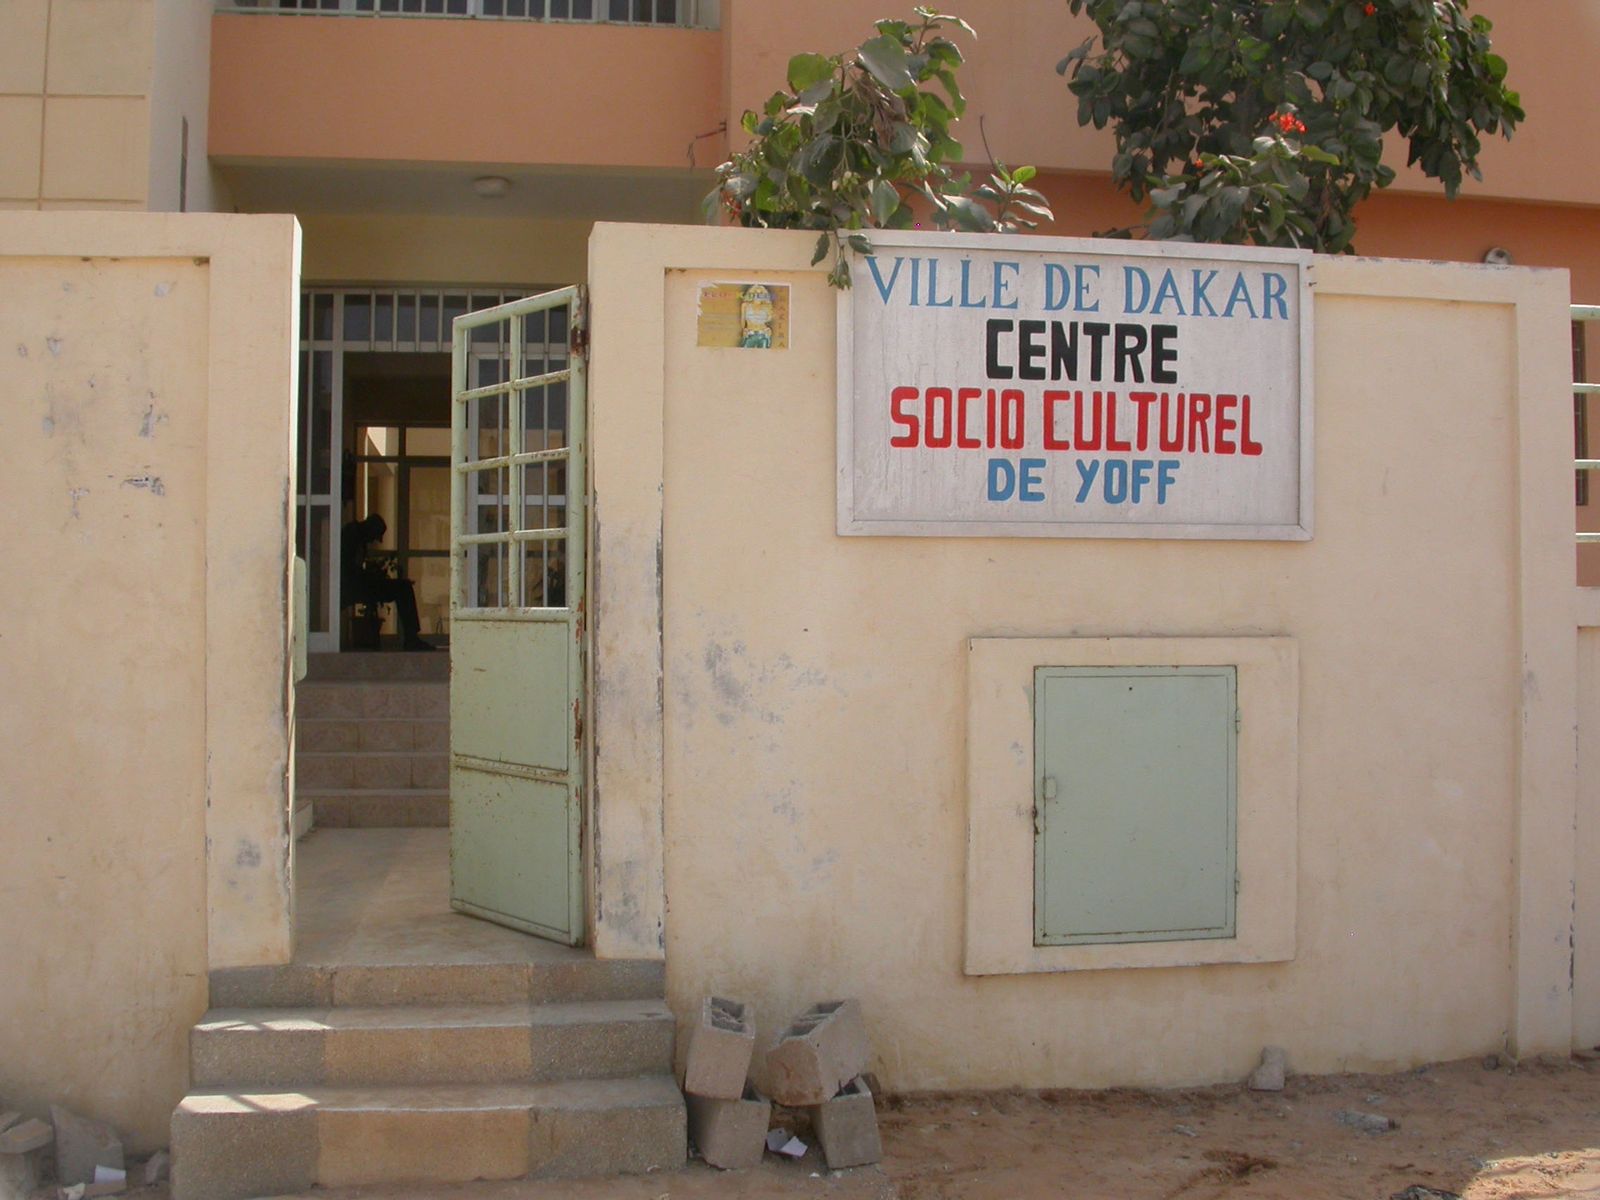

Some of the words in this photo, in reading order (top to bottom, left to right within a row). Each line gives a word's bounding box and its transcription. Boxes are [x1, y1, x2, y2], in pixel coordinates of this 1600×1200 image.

[865, 255, 1020, 309] VILLE
[1043, 262, 1100, 312] DE
[1123, 265, 1289, 320] DAKAR
[985, 318, 1178, 385] CENTRE
[890, 387, 1025, 450] SOCIO
[1043, 390, 1263, 456] CULTUREL
[987, 459, 1046, 502] DE
[1076, 459, 1180, 505] YOFF
